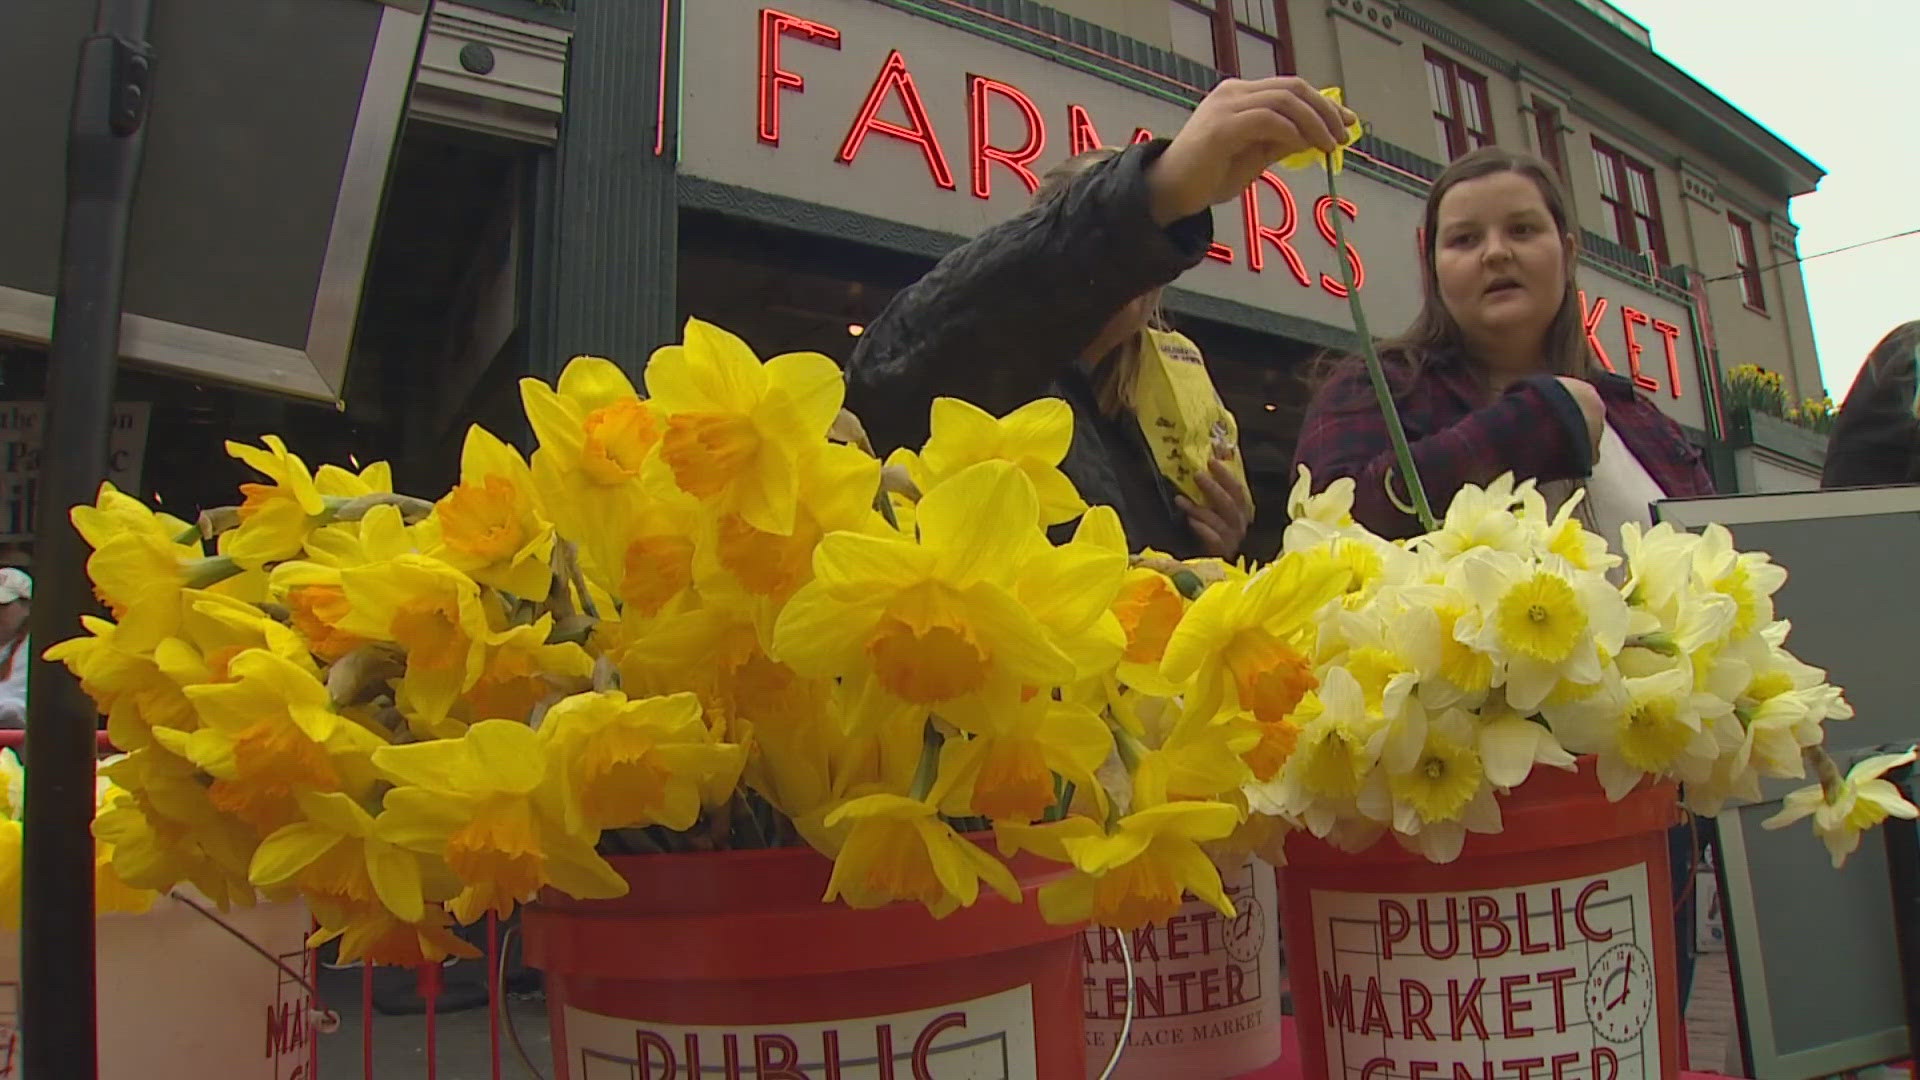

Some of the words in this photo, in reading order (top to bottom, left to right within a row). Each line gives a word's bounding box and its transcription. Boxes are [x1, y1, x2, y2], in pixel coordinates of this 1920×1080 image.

[757, 8, 1364, 297] FARRS
[1378, 880, 1615, 961] PUBLIC
[1192, 1010, 1264, 1041] MARKET
[1323, 968, 1577, 1041] MARKET
